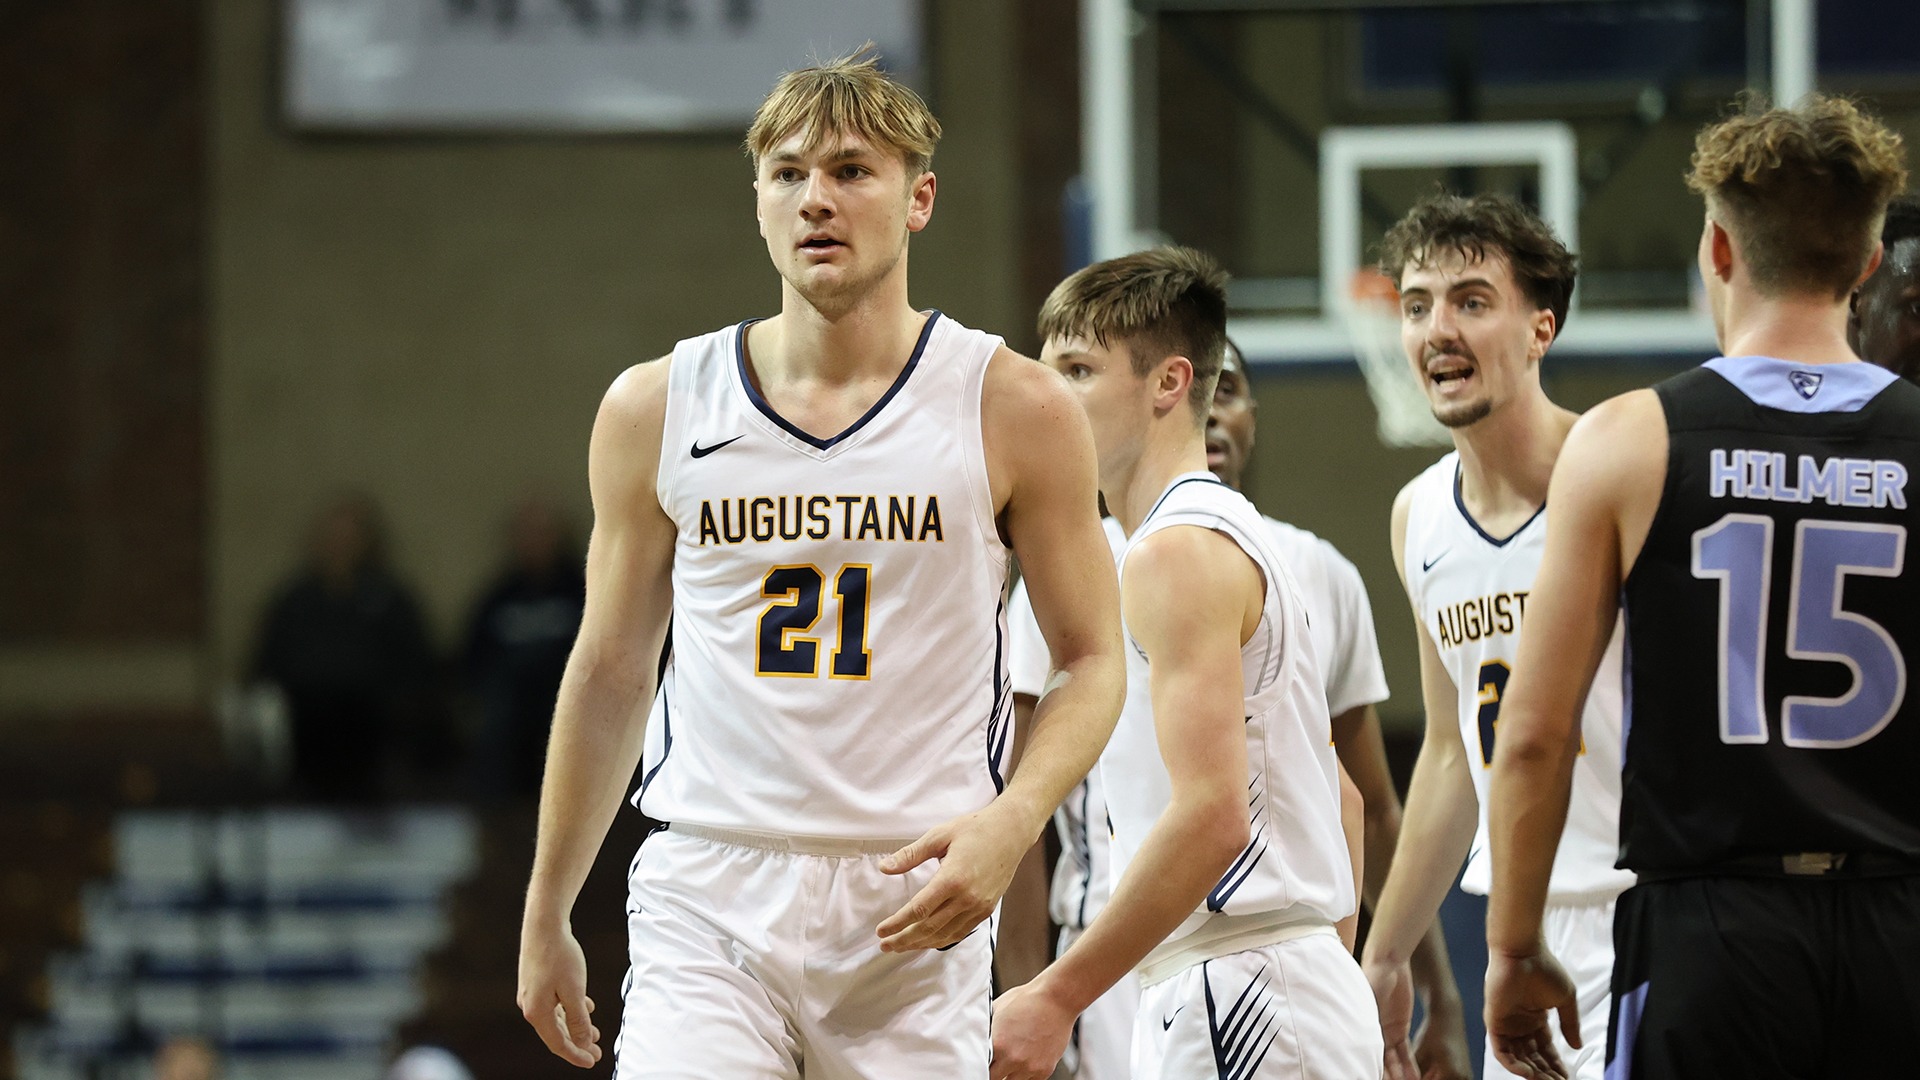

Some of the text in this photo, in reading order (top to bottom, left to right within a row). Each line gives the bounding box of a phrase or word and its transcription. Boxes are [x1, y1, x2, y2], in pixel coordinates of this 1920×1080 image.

[1710, 449, 1907, 509] HILMER
[699, 495, 944, 546] AUGUSTANA
[755, 562, 872, 681] 21
[1437, 591, 1530, 651] AUGUST
[1691, 513, 1907, 749] 15
